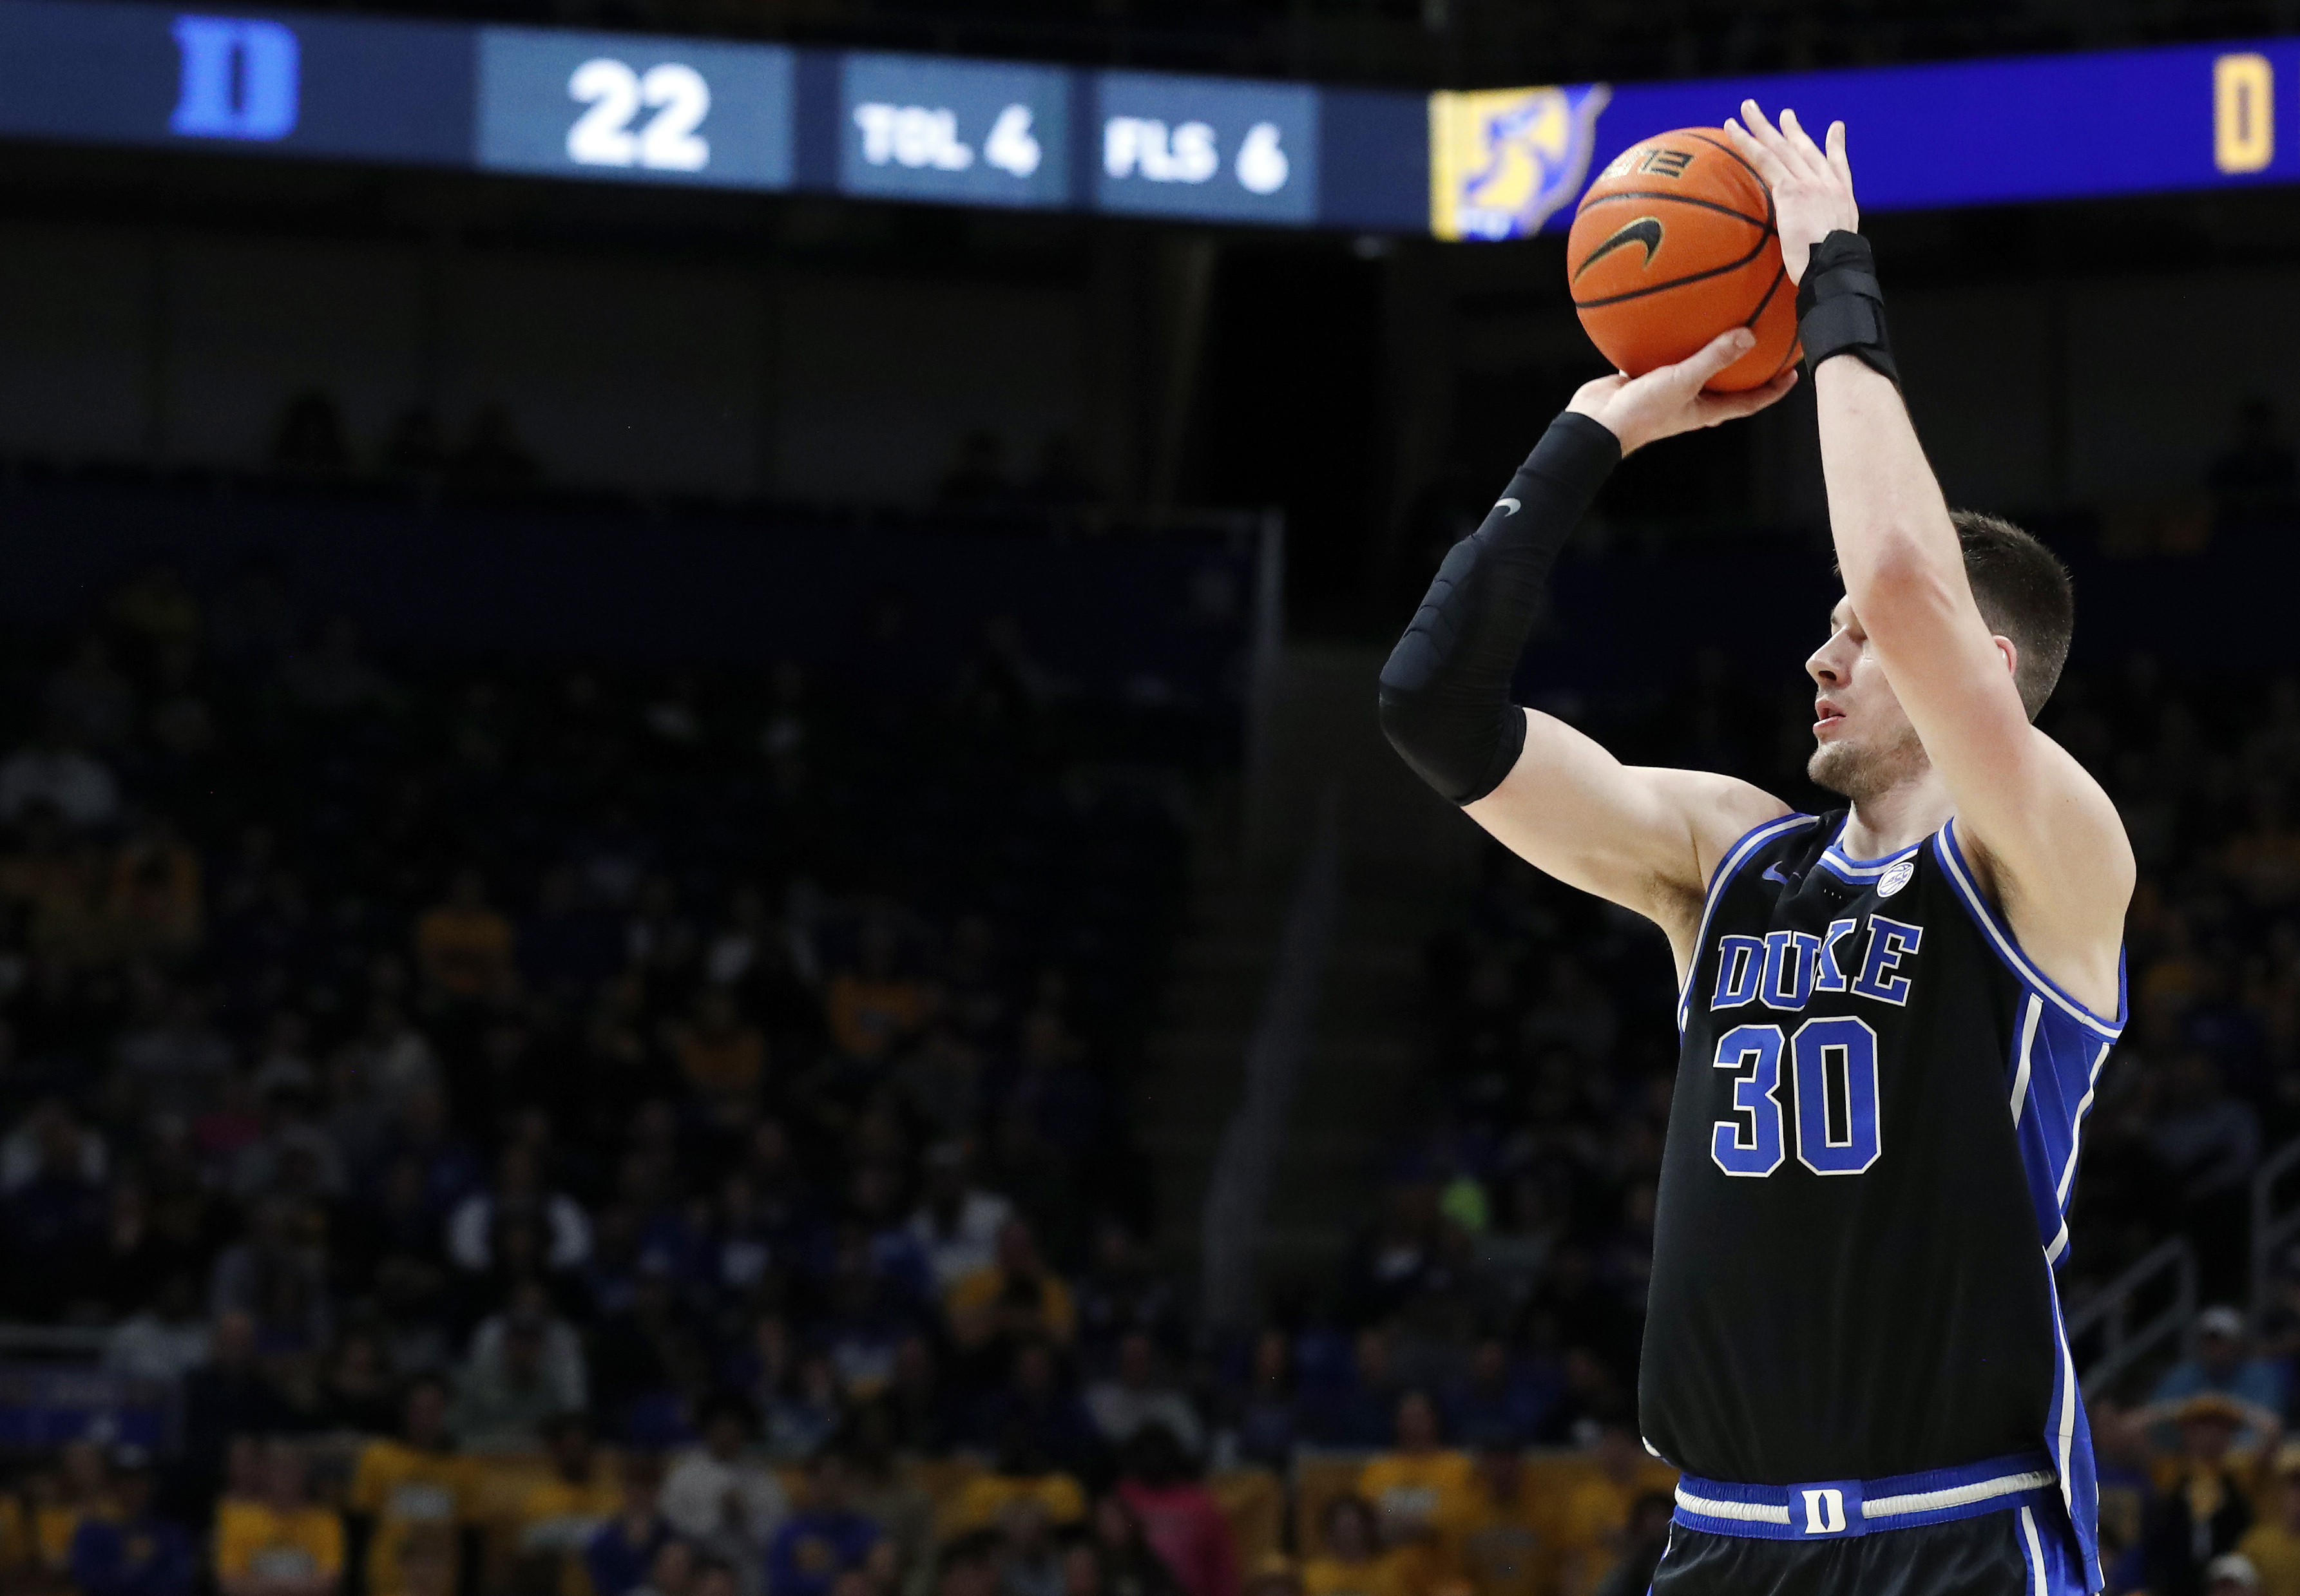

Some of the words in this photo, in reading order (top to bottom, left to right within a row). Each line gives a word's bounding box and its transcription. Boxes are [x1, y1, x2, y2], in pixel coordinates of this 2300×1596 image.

[169, 15, 300, 140] D
[566, 58, 711, 171] 22
[854, 102, 973, 171] TOL
[984, 104, 1040, 177] 4
[1104, 116, 1218, 184] FLS
[1235, 122, 1289, 195] 6
[1711, 913, 1924, 1012] DUKE
[1711, 1015, 1882, 1178] 30
[1801, 1488, 1846, 1534] D
